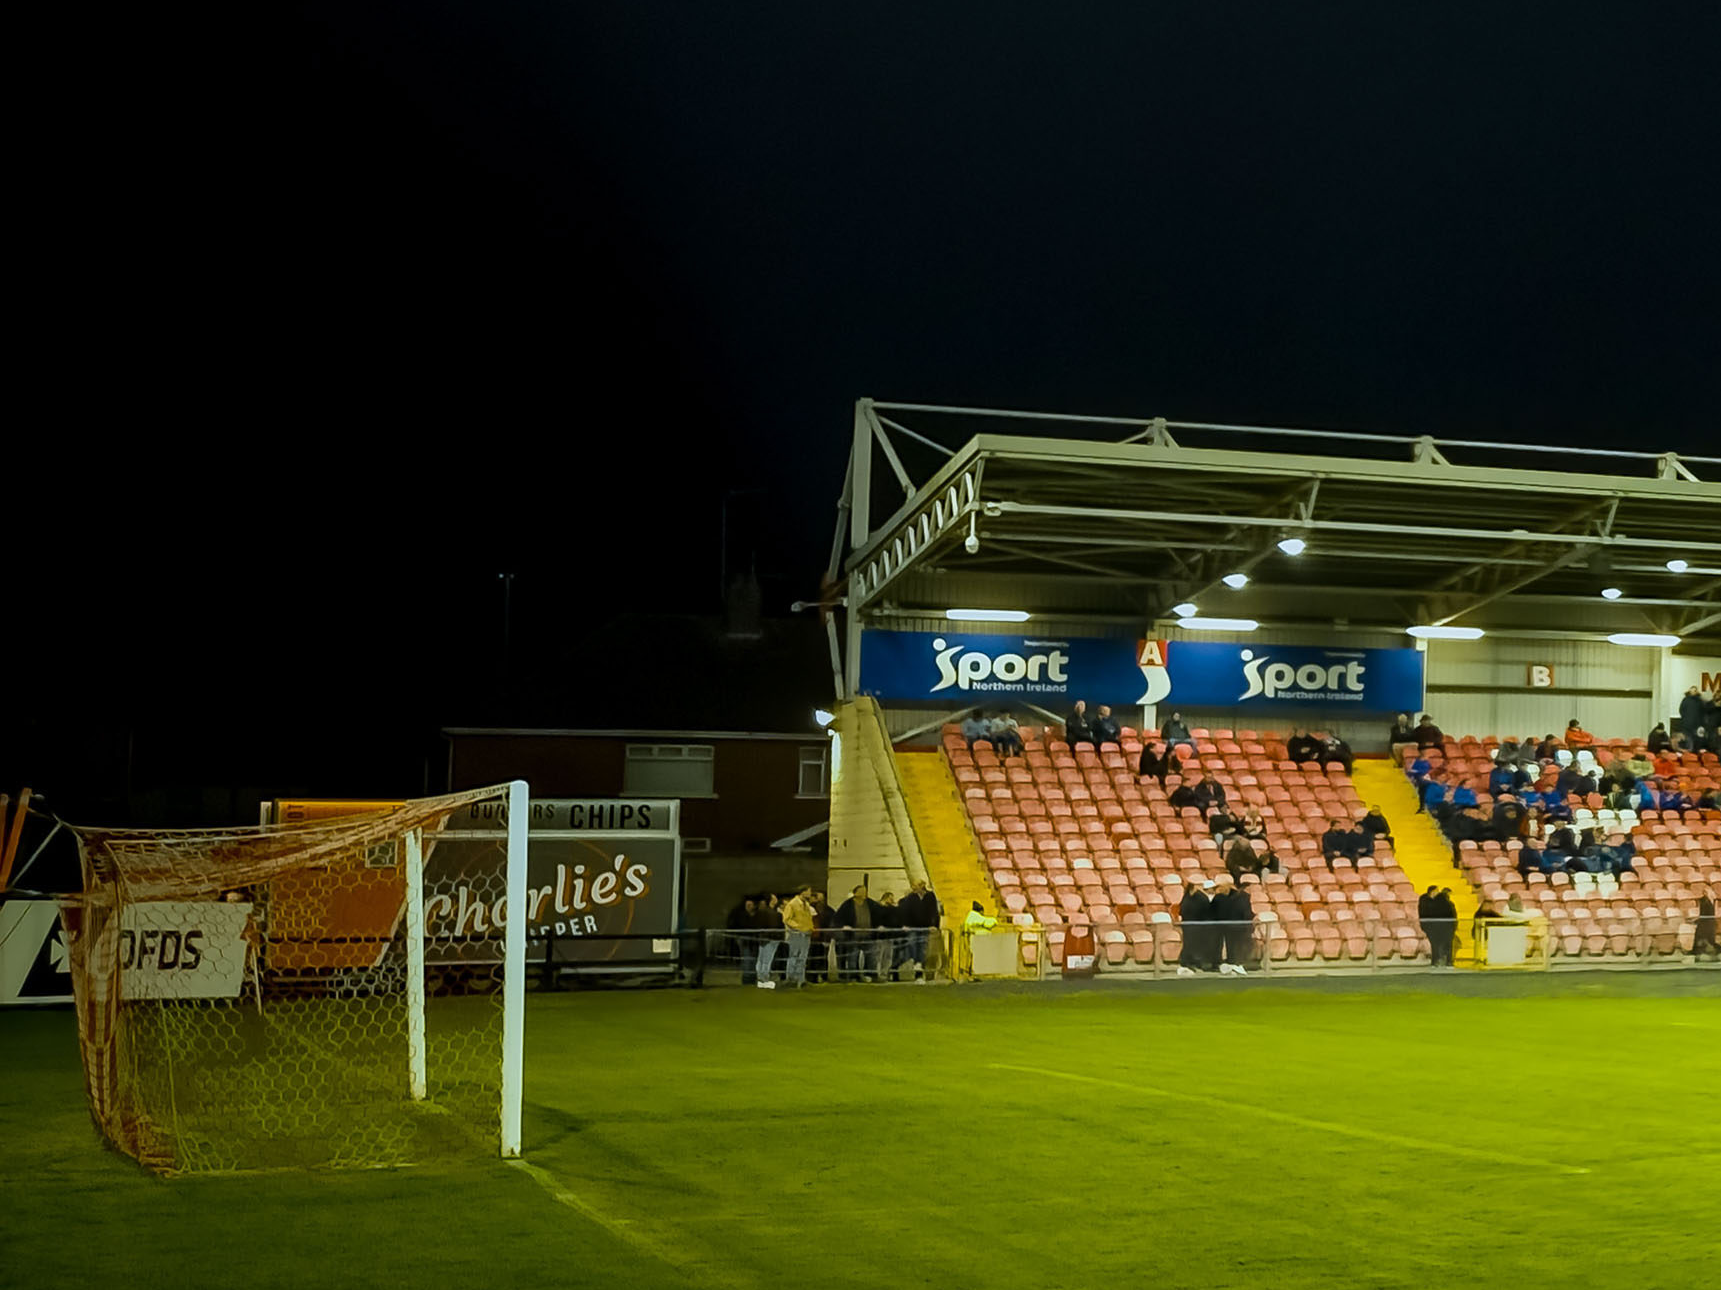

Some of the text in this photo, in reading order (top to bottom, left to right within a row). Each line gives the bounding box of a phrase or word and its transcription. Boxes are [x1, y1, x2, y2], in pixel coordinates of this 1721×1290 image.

[930, 636, 1069, 693] Sport
[1140, 641, 1163, 666] A
[972, 682, 1067, 693] Northern Ireland
[1238, 649, 1366, 701] Sport
[1532, 666, 1551, 686] B
[570, 804, 651, 829] CHIPS
